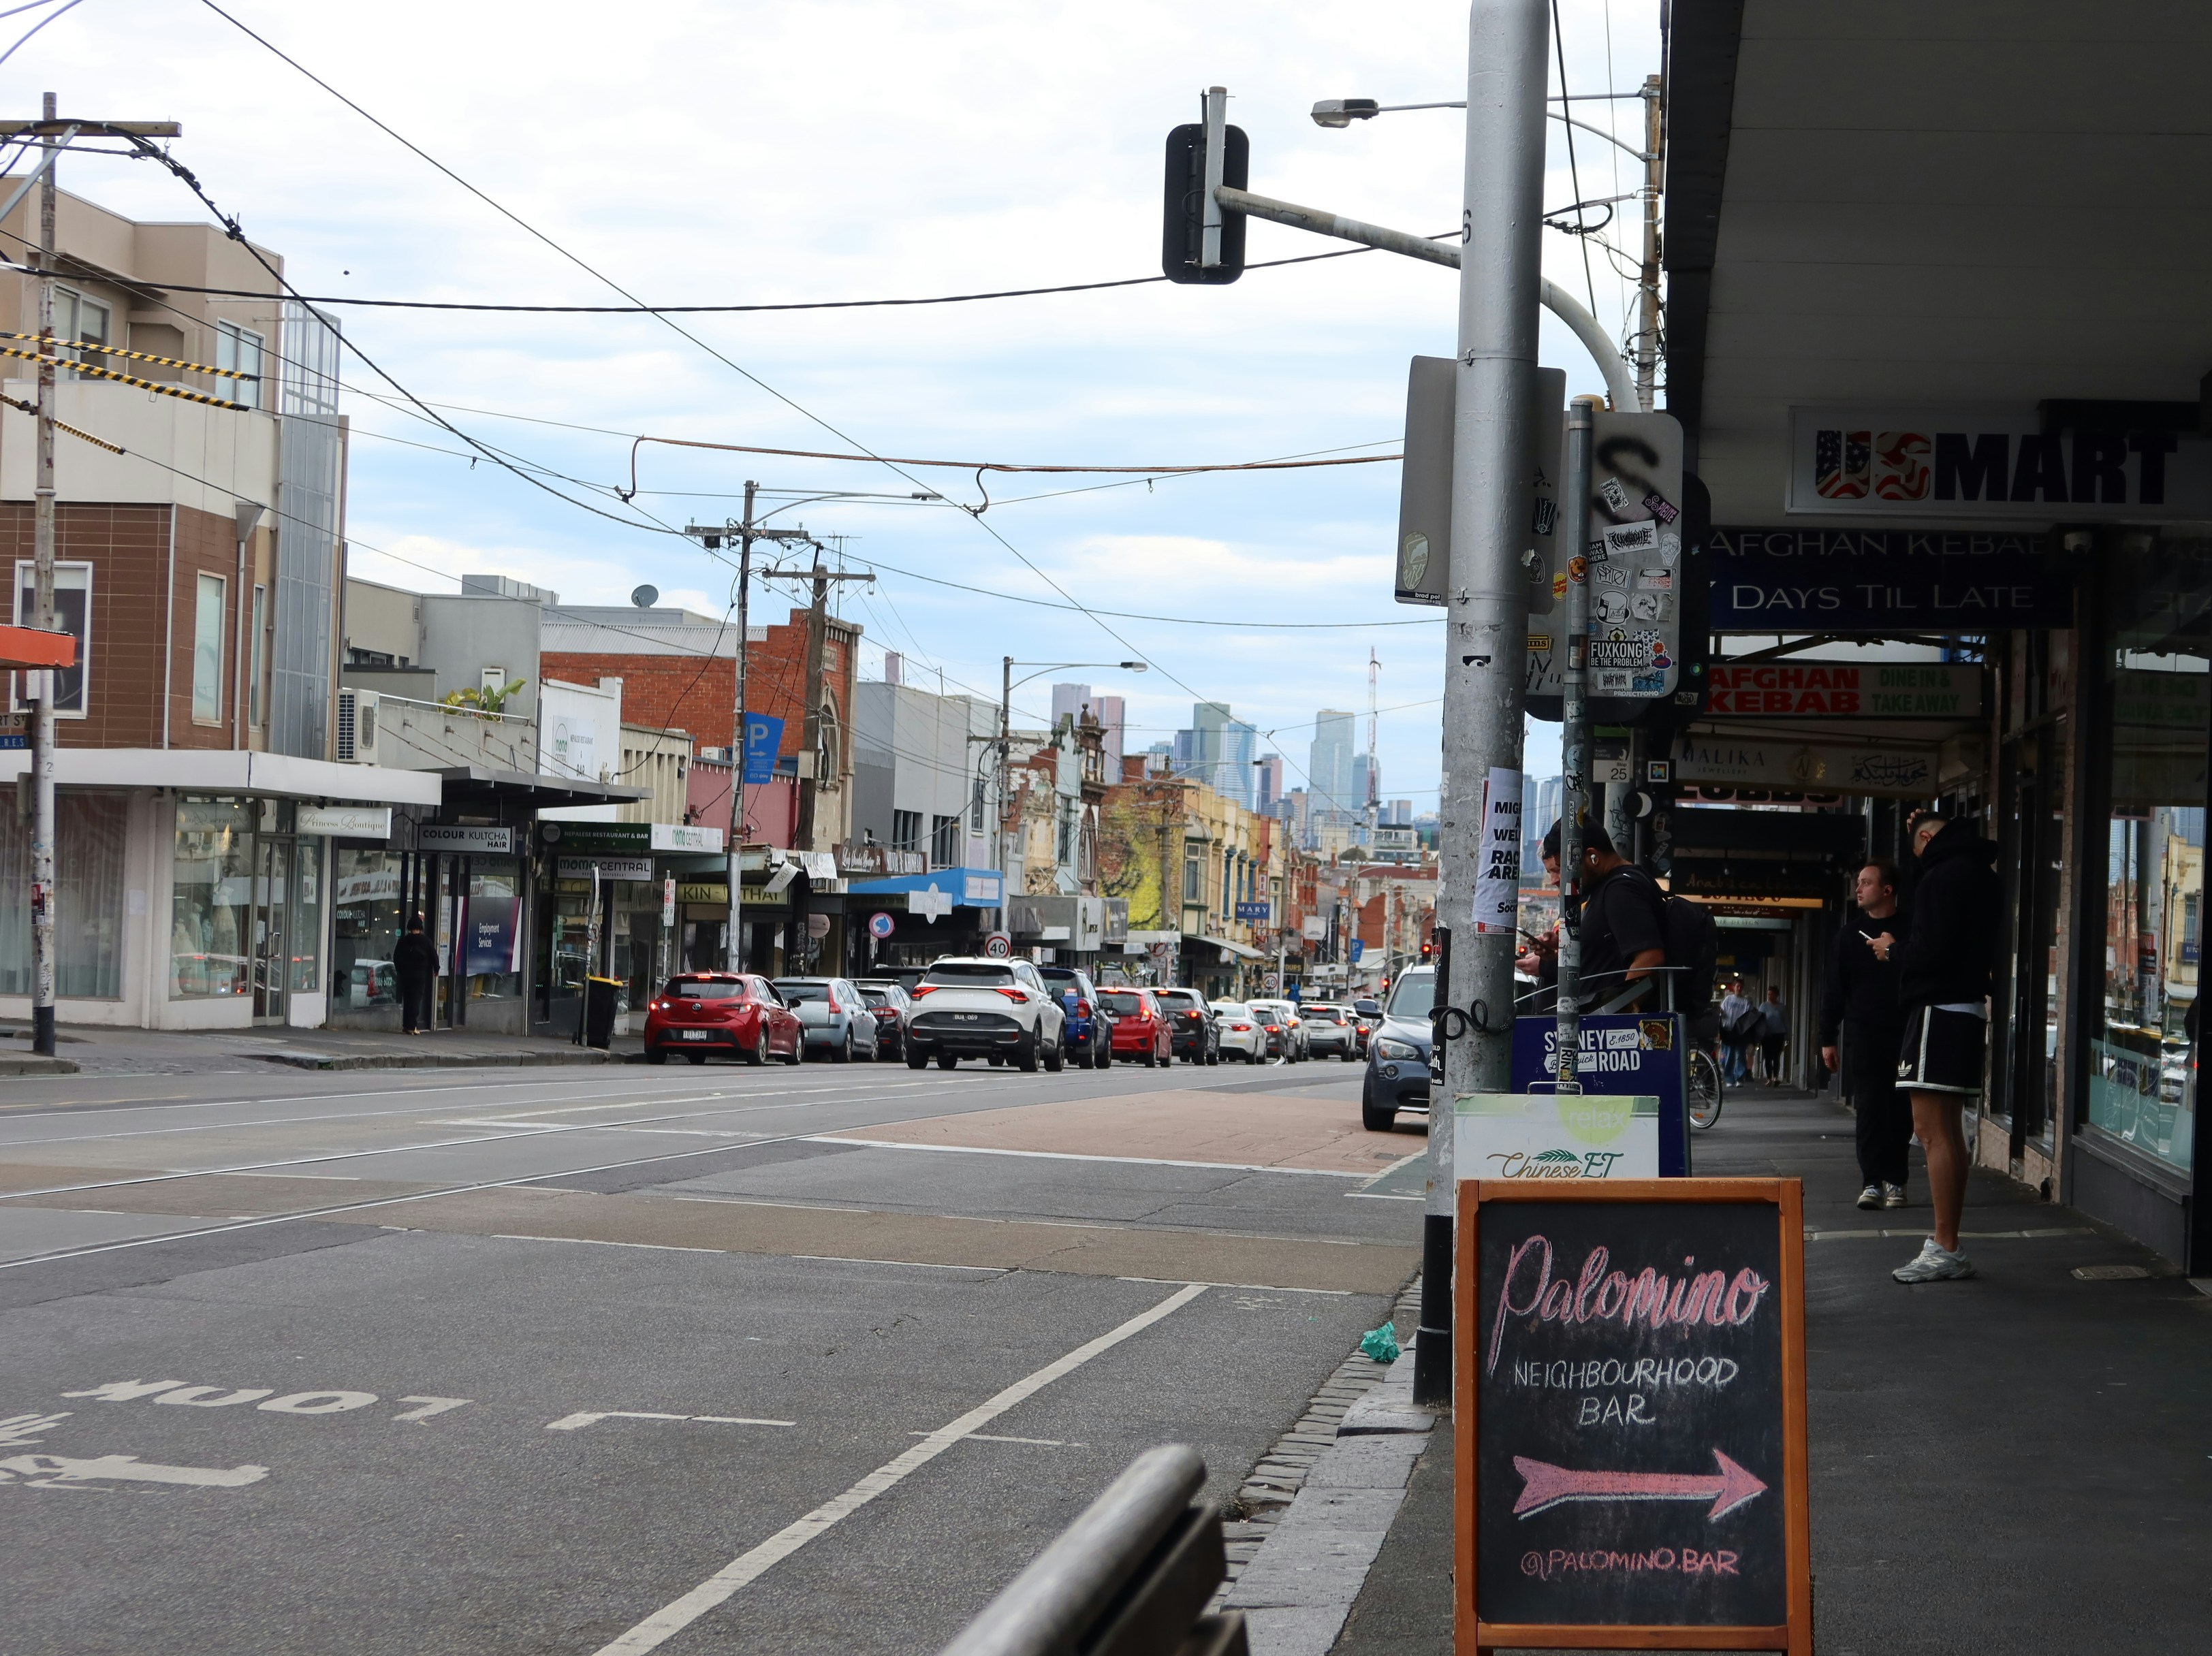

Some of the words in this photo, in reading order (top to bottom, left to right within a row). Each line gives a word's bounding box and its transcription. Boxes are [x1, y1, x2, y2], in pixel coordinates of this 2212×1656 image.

[1935, 432, 2178, 505] MART
[1709, 531, 1889, 557] AFGHAN
[1732, 586, 1840, 610] DAYS
[1856, 584, 1916, 609] TIL
[1933, 584, 2035, 609] LATE
[1590, 642, 1643, 658] FUXKONG
[1590, 658, 1600, 666] BE
[1600, 658, 1612, 666] THE
[1613, 658, 1643, 667] PROBLEM
[1709, 667, 1860, 690] AFGHAN
[1880, 668, 1916, 688] DINE
[1920, 669, 1936, 688] IN
[1940, 669, 1950, 688] &
[1705, 690, 1861, 713] KEBAB
[1871, 693, 1913, 713] TAKE
[1914, 695, 1961, 714] AWAY
[750, 724, 769, 748] P
[1681, 748, 1765, 767] MALIKA
[1611, 767, 1627, 780] 25
[300, 812, 338, 828] Princess
[341, 814, 385, 831] Boutique
[423, 829, 464, 840] COLOUR
[469, 831, 507, 842] KULTCHA
[600, 861, 650, 872] CENTRAL
[683, 887, 711, 900] KIN
[1237, 905, 1268, 914] MARY
[479, 923, 500, 936] Employment
[478, 937, 492, 948] Services
[990, 943, 1006, 954] 40
[1352, 942, 1359, 951] P
[1545, 1030, 1607, 1052] SNEY
[1599, 1051, 1641, 1072] ROAD
[1568, 1106, 1627, 1128] relax
[1487, 1152, 1581, 1179] Chinese
[1581, 1152, 1625, 1179] ET
[1487, 1235, 1770, 1378] Palomino
[1514, 1355, 1739, 1390] NEIGHBOURHOOD
[1578, 1392, 1656, 1428] BAR
[1521, 1547, 1741, 1581] @PALOMINO.BAR
